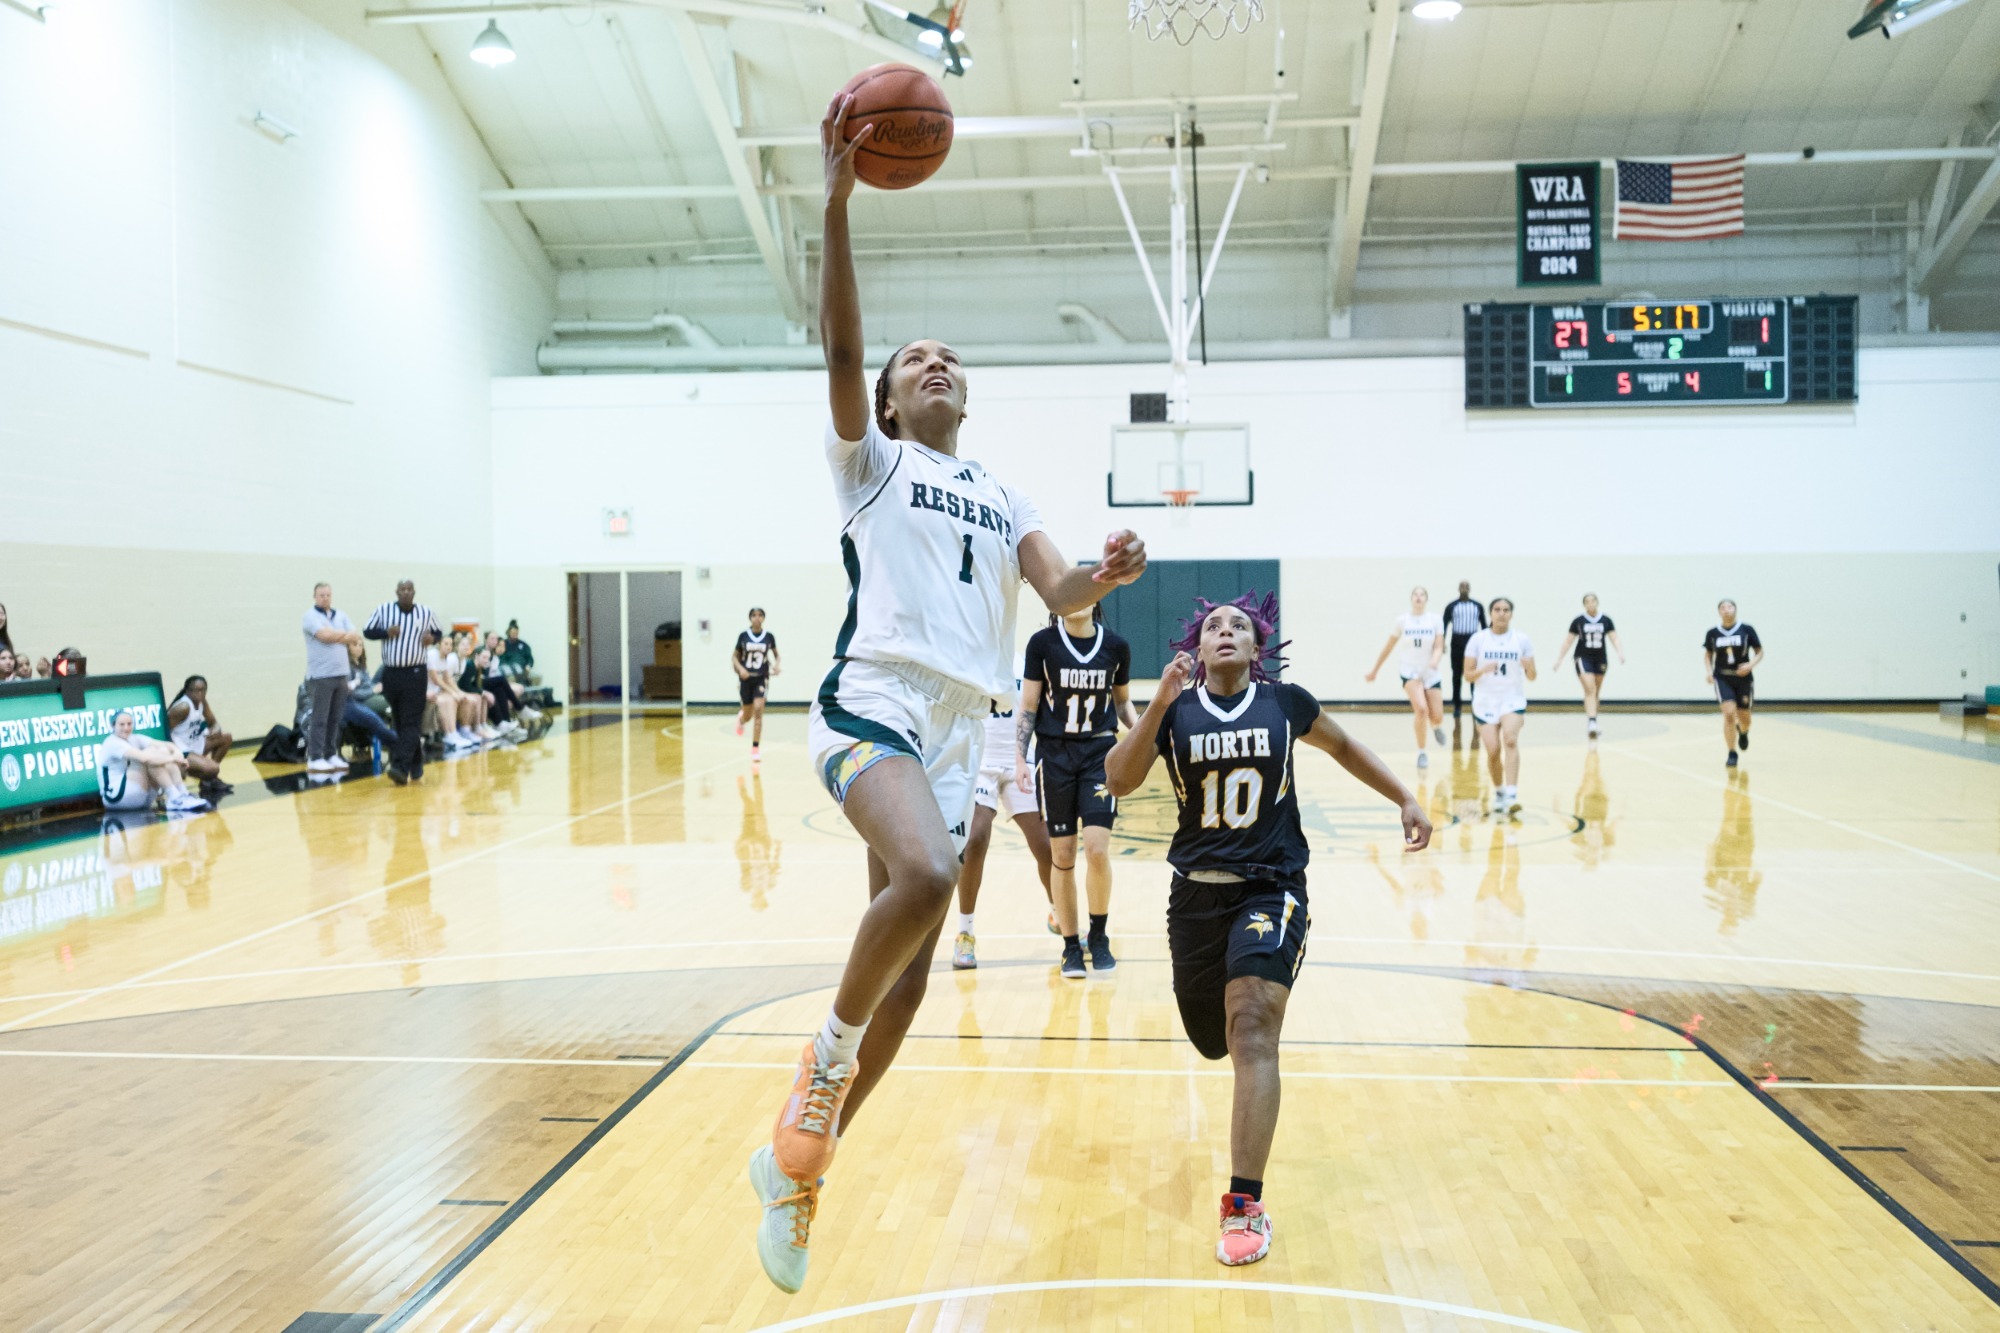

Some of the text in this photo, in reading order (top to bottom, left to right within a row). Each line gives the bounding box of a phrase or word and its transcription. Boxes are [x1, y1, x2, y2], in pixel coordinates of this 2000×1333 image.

[1529, 175, 1586, 202] WRA
[1526, 235, 1591, 251] CHAMPIONS
[1541, 256, 1577, 274] 2024
[1552, 306, 1584, 320] WRA
[1633, 305, 1699, 332] 5:17
[1722, 302, 1775, 317] VISITOR
[1555, 321, 1588, 348] 27
[1761, 317, 1769, 343] 1
[1668, 337, 1683, 359] 2
[1566, 374, 1573, 394] 1
[1617, 372, 1632, 394] 5
[1685, 371, 1699, 392] 4
[1765, 370, 1772, 390] 1
[959, 533, 973, 584] 1
[1060, 668, 1107, 690] NORTH
[1065, 694, 1097, 734] 11
[31, 711, 95, 744] RESERVE
[1189, 728, 1271, 764] NORTH
[1200, 767, 1264, 830] 10
